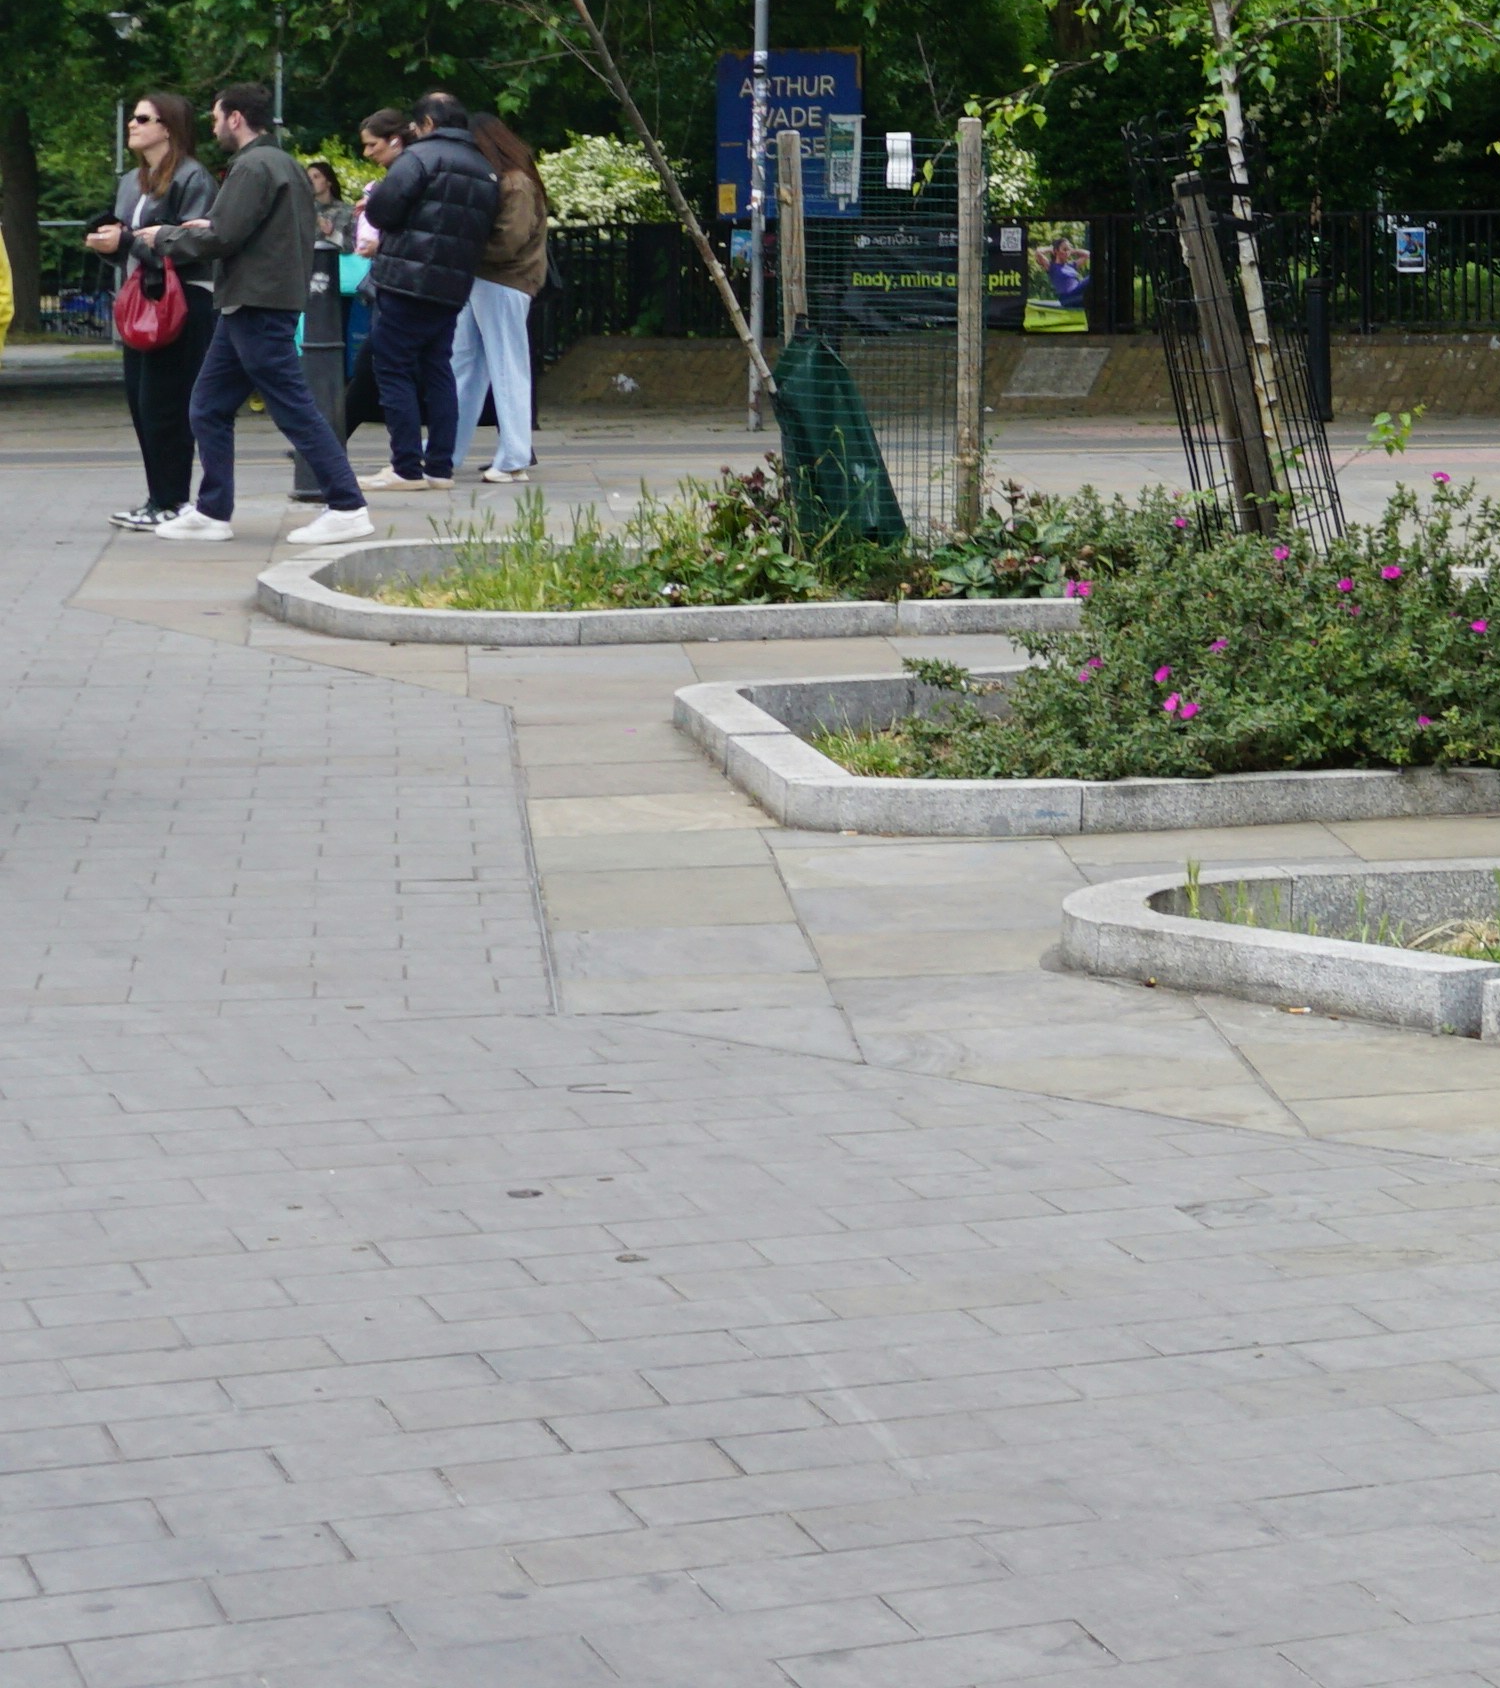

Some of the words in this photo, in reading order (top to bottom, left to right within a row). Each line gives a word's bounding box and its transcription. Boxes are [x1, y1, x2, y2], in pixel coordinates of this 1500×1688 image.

[766, 106, 822, 128] ADE
[901, 271, 942, 287] mind
[988, 270, 1021, 291] pirit
